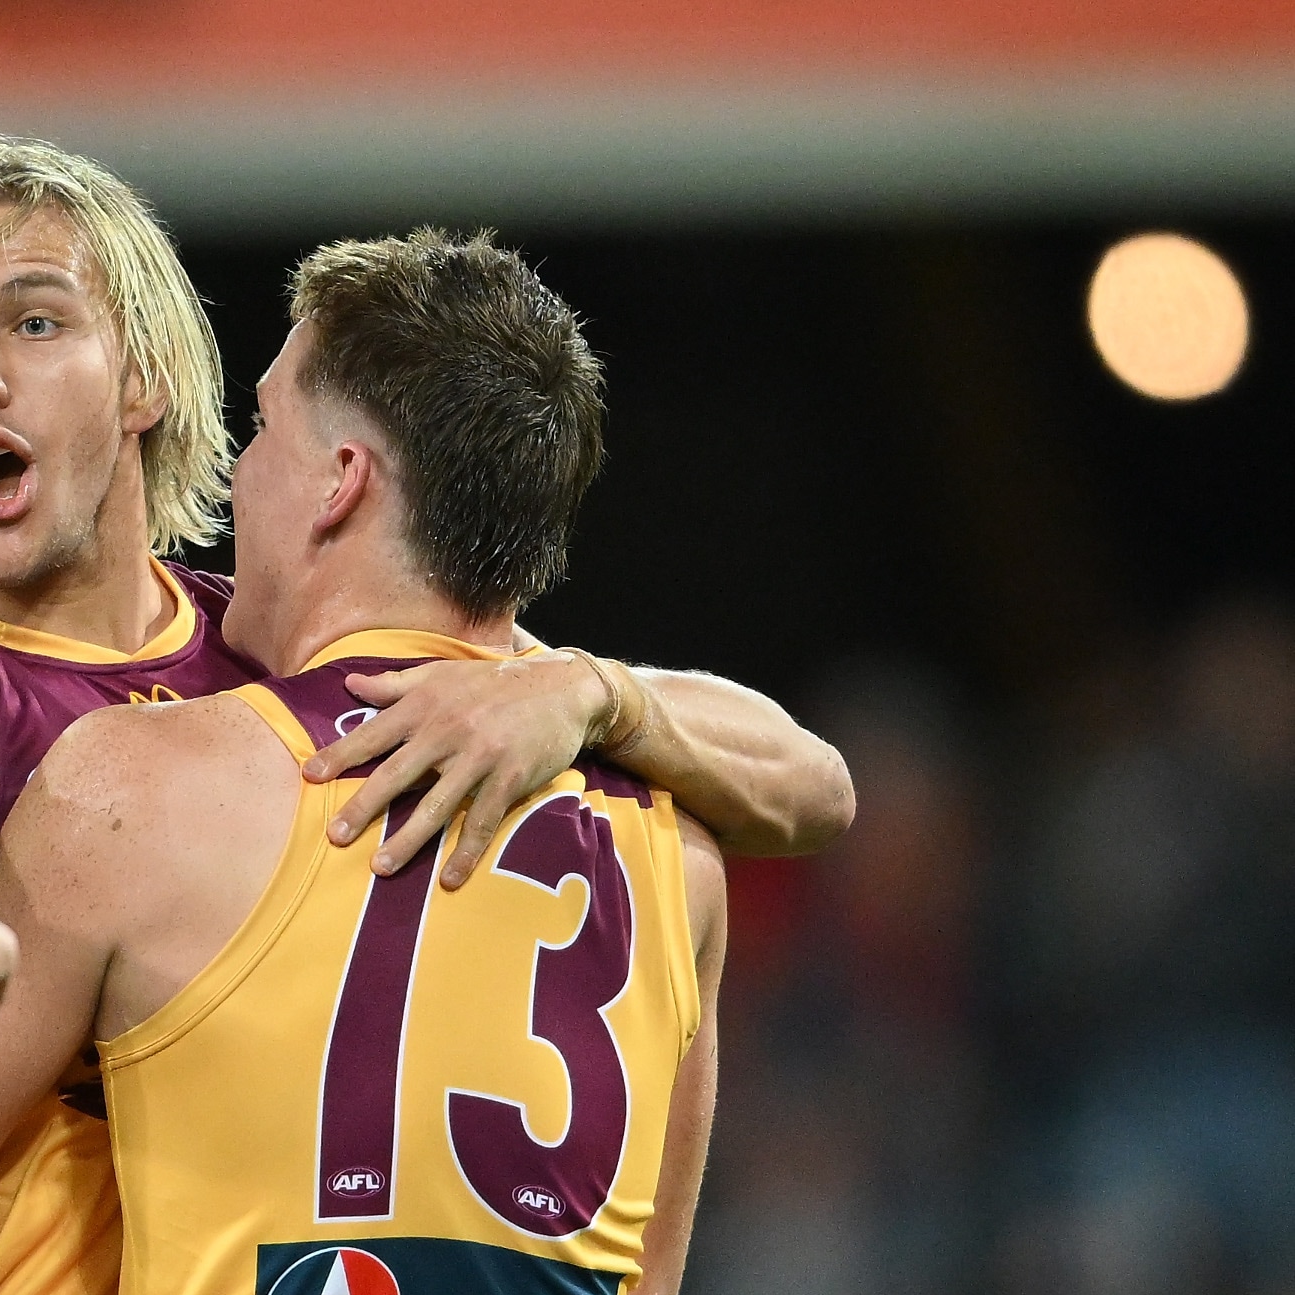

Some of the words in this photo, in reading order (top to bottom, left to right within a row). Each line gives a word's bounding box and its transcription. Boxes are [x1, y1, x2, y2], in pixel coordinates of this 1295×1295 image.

[313, 786, 637, 1242] 13
[333, 1173, 381, 1191] AFL
[517, 1189, 561, 1215] AFL
